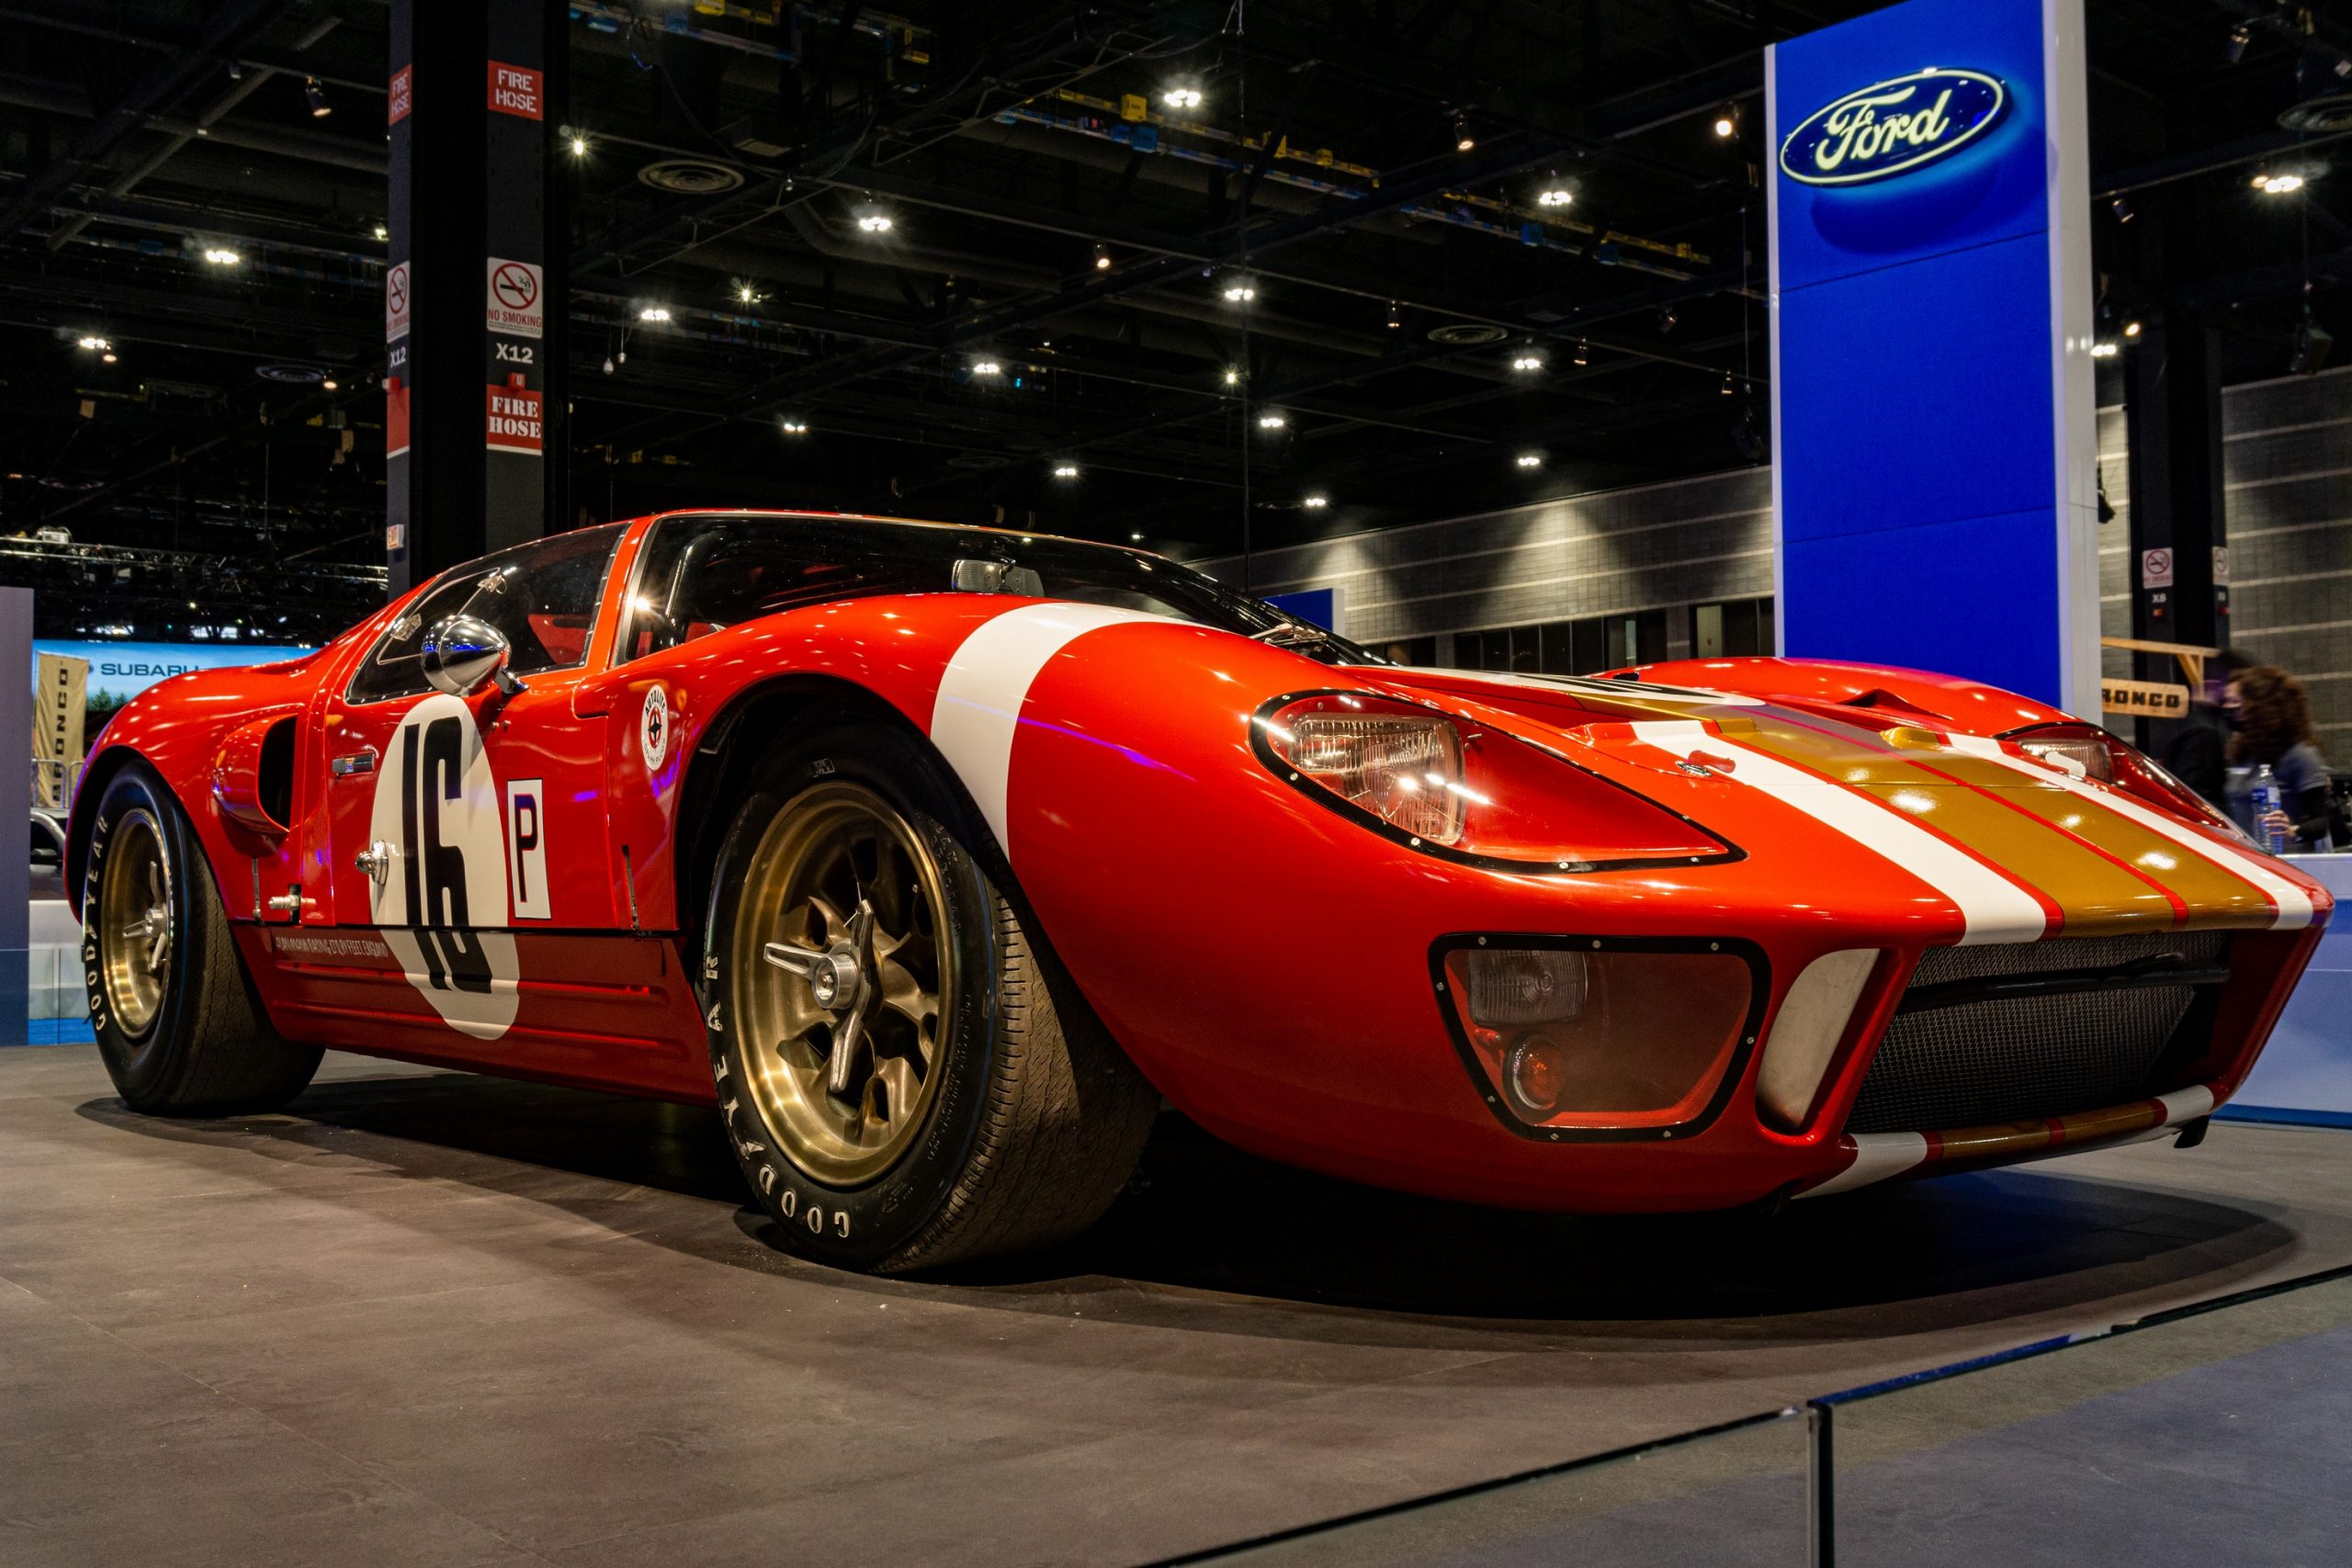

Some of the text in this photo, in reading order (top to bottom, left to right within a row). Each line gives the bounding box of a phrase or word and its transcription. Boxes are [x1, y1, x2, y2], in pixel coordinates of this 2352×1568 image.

[498, 69, 533, 92] FIRE
[495, 88, 537, 113] HOSE
[1815, 85, 1952, 170] Ford
[488, 308, 501, 321] NO
[503, 310, 542, 329] SMOKING
[390, 346, 406, 368] X12
[496, 343, 533, 364] X12
[492, 396, 538, 418] FIRE
[489, 415, 541, 439] HOSE
[645, 690, 666, 717] AUTOLITE
[2101, 689, 2180, 708] RONCO
[52, 669, 69, 802] BRONCO
[401, 716, 493, 994] 16
[513, 793, 538, 904] P
[85, 816, 109, 1032] GOODYEAR
[706, 954, 850, 1238] GOODYEAR
